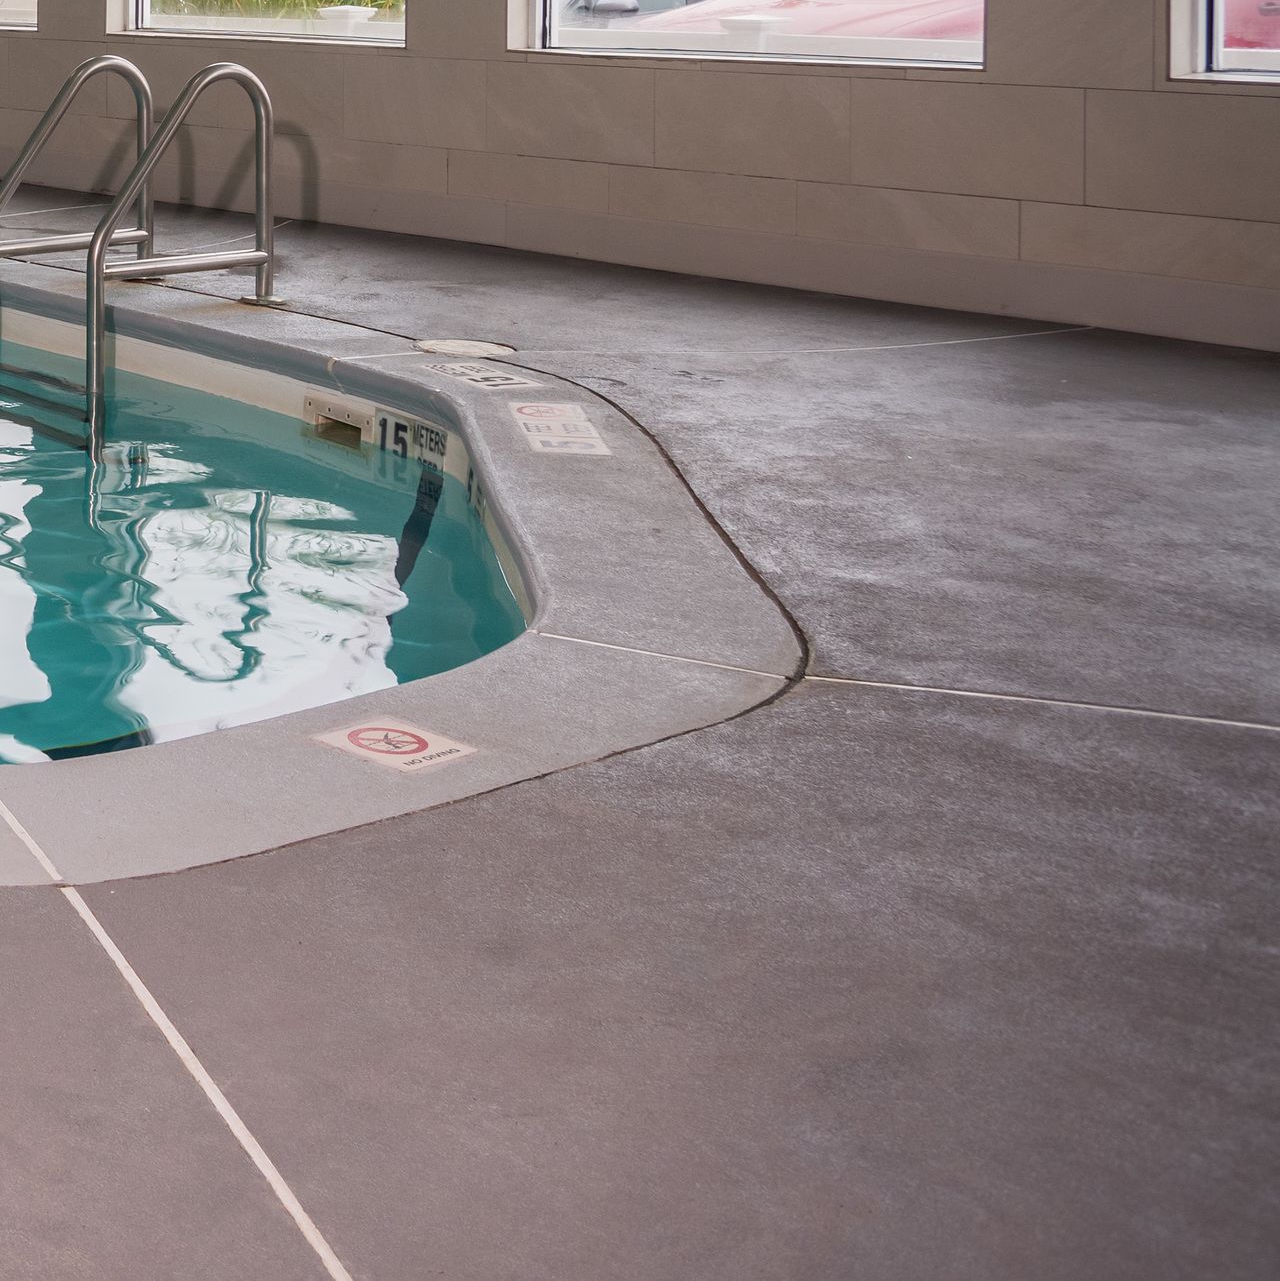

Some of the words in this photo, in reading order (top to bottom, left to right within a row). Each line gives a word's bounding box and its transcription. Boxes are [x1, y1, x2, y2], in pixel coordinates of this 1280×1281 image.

[413, 423, 447, 456] METERS
[403, 758, 423, 767] NO
[423, 748, 461, 762] DIVING
